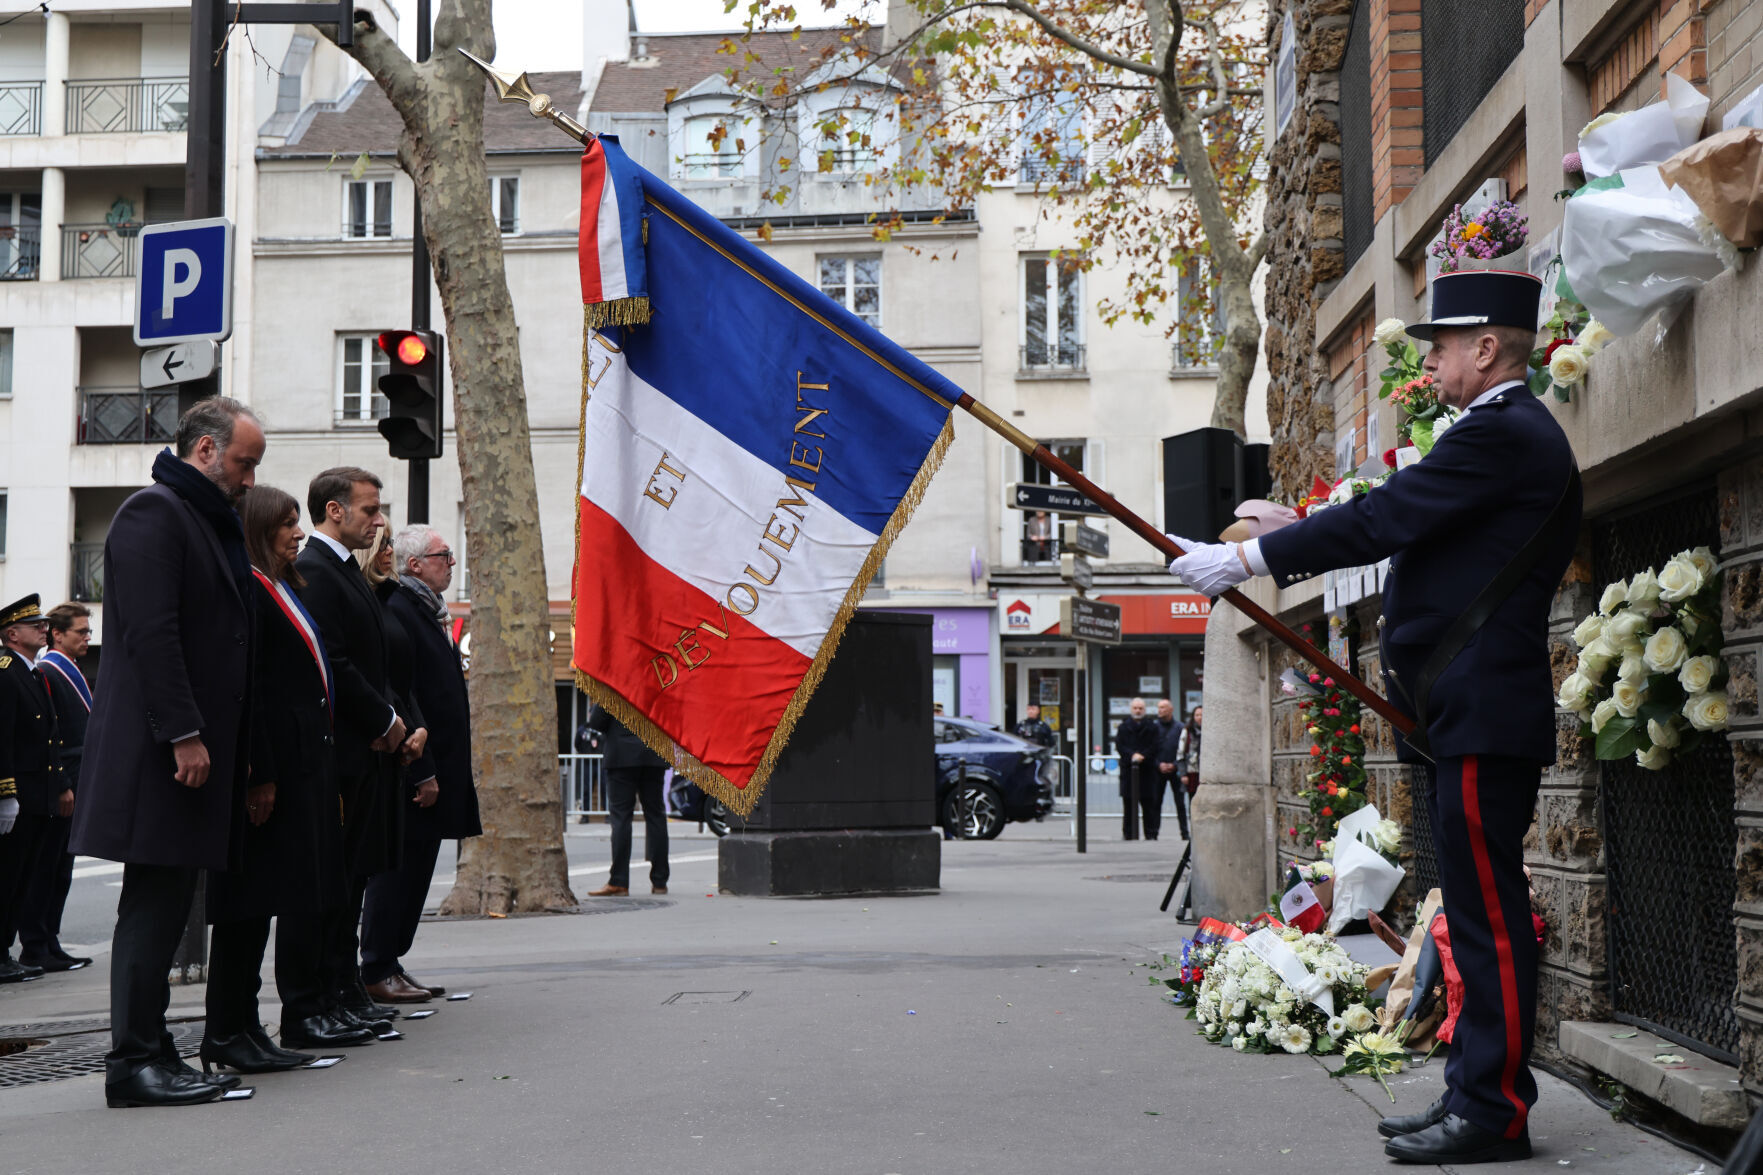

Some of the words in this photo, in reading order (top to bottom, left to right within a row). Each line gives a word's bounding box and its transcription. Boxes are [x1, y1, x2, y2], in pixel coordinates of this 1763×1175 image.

[162, 247, 202, 320] P
[643, 452, 686, 511] ET
[650, 370, 830, 690] DÉVOUEMENT
[1008, 616, 1030, 625] ERA
[1171, 602, 1199, 614] ERA
[932, 638, 958, 649] auté
